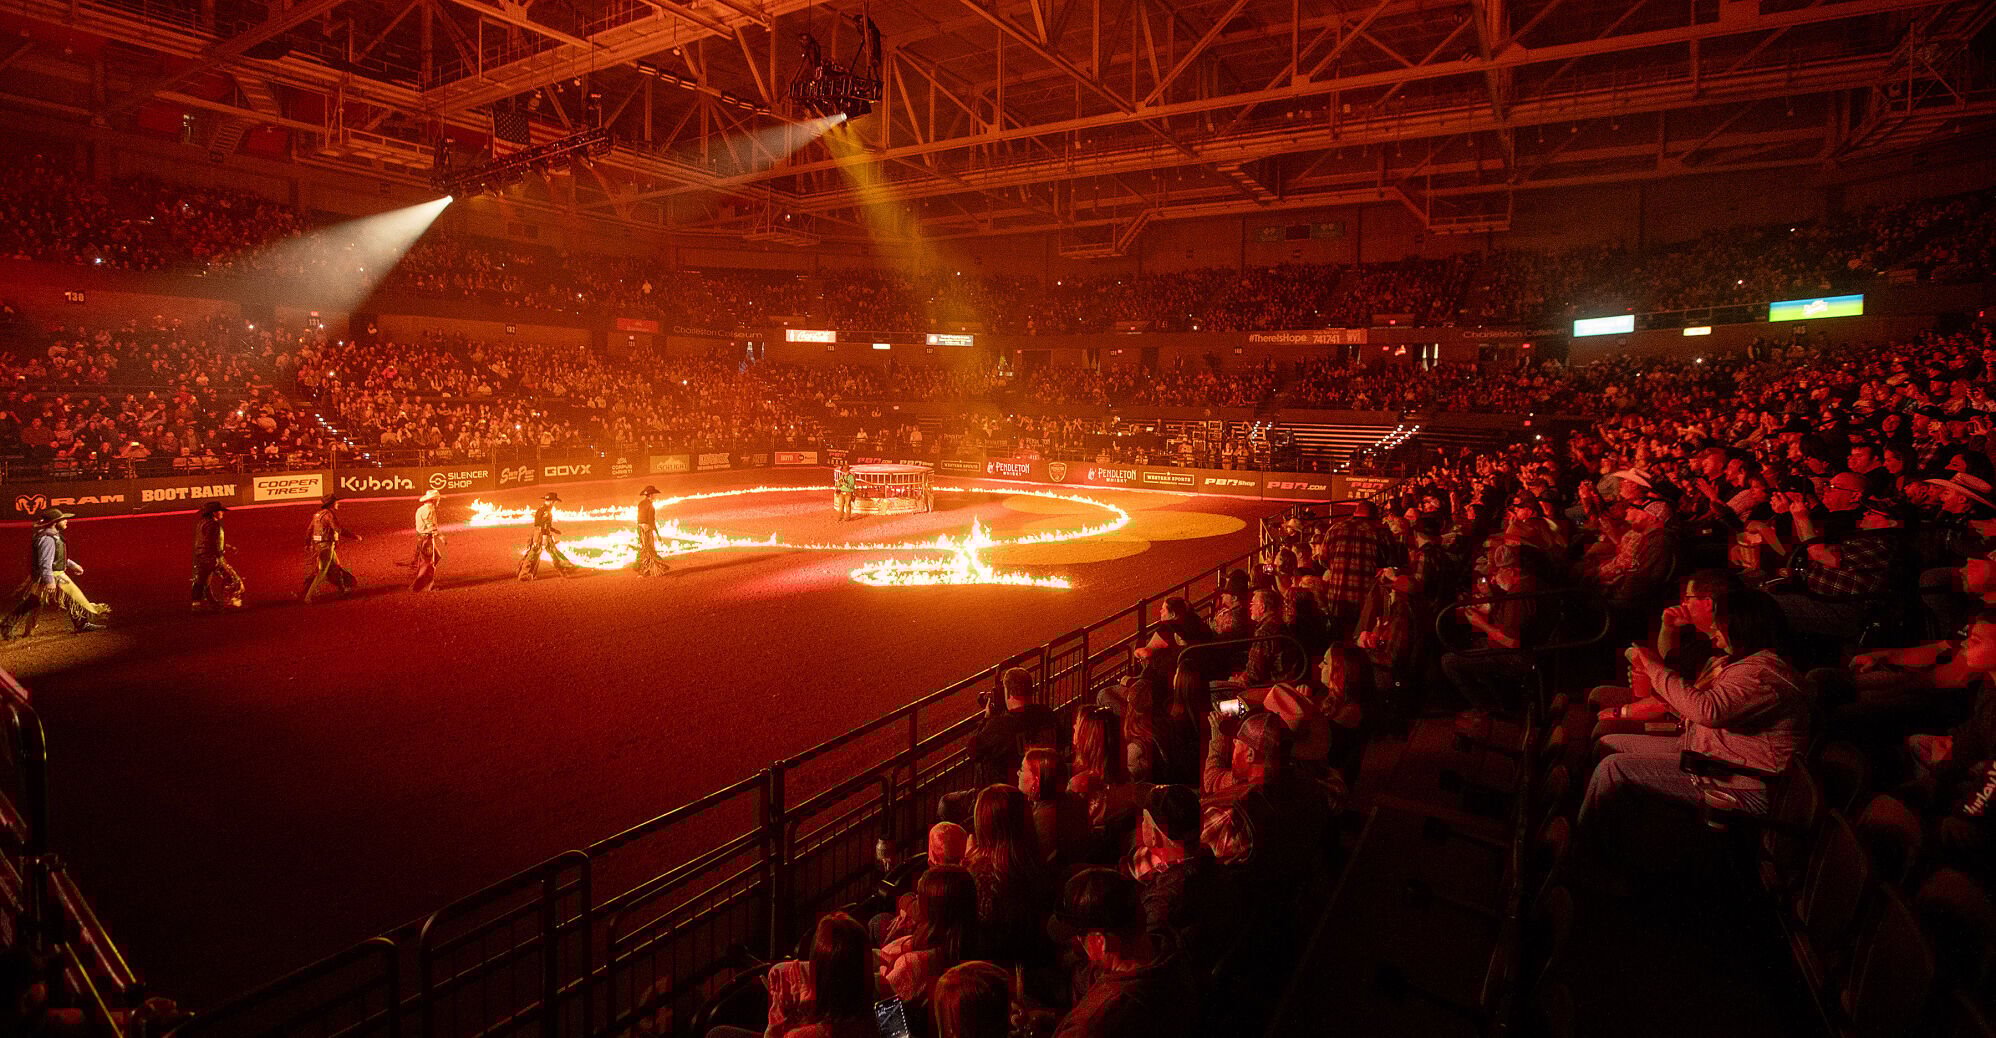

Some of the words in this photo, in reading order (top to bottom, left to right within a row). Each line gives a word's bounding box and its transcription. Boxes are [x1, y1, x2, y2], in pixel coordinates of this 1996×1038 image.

[673, 325, 716, 337] Charleston
[1249, 333, 1308, 344] #ThereIsHope
[1312, 334, 1340, 344] 741741
[544, 464, 592, 477] GOVX
[995, 461, 1029, 474] PENDLETON
[447, 470, 489, 480] SILENCER
[1098, 467, 1137, 481] PENDLETON
[257, 478, 320, 489] COOPER
[340, 475, 415, 492] Kubota
[447, 480, 473, 489] SHOP
[142, 487, 189, 502] BOOT
[190, 484, 236, 499] BARN
[266, 486, 310, 496] TIRES
[50, 494, 125, 506] RAM
